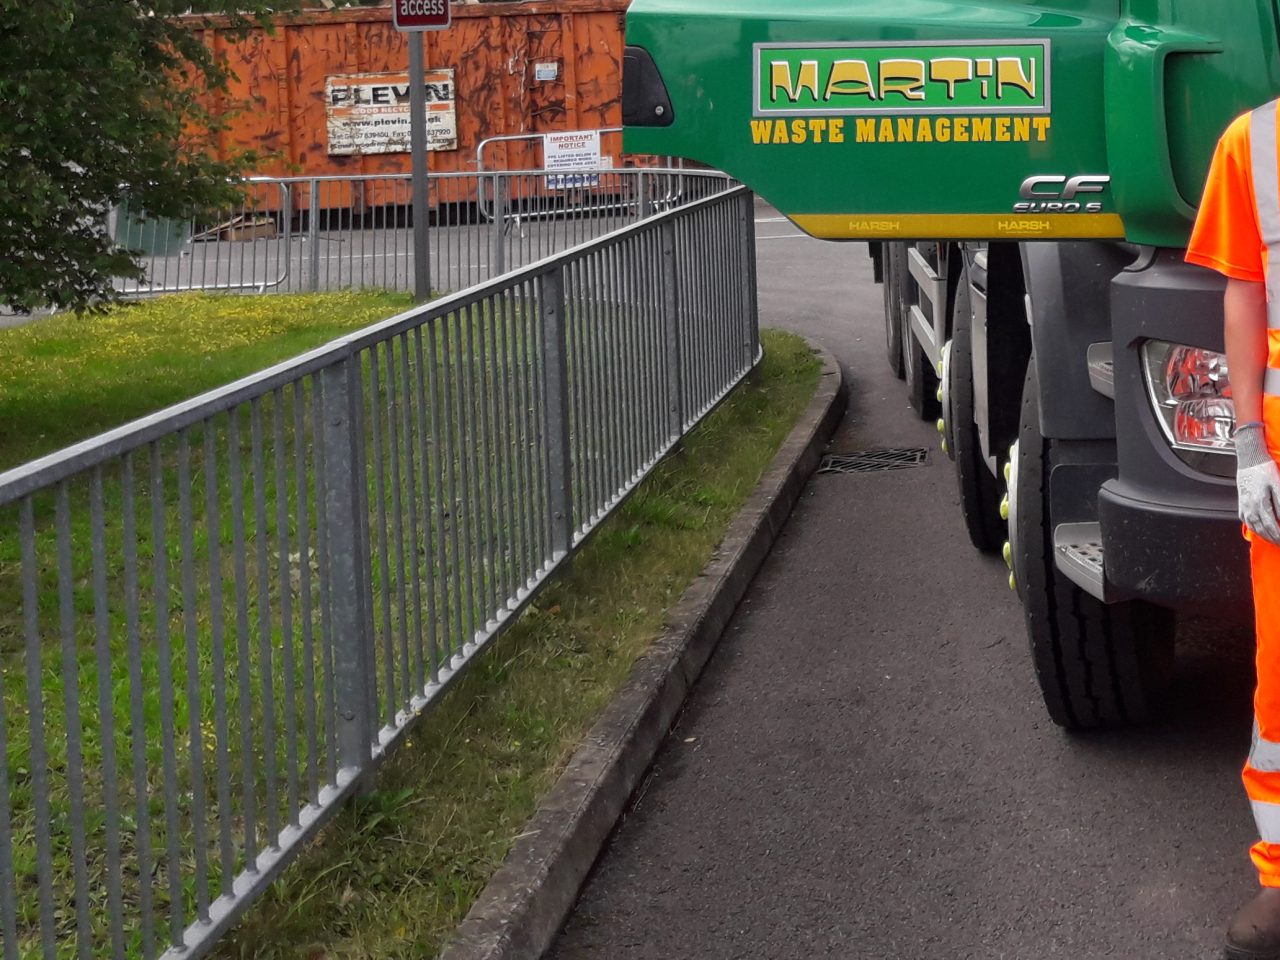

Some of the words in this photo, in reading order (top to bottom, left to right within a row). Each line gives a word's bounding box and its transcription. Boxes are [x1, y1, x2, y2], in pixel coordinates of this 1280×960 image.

[401, 0, 445, 16] access
[770, 57, 1036, 102] MARTIN
[331, 83, 450, 106] PLEVN
[750, 120, 844, 144] WASTE
[856, 117, 1051, 143] MANAGEMENT
[550, 134, 594, 143] IMPORTANT
[558, 142, 587, 150] NOTICE
[1019, 174, 1111, 200] CF
[1013, 202, 1081, 214] EURO
[848, 221, 900, 231] HARSH
[998, 220, 1050, 231] HARSH
